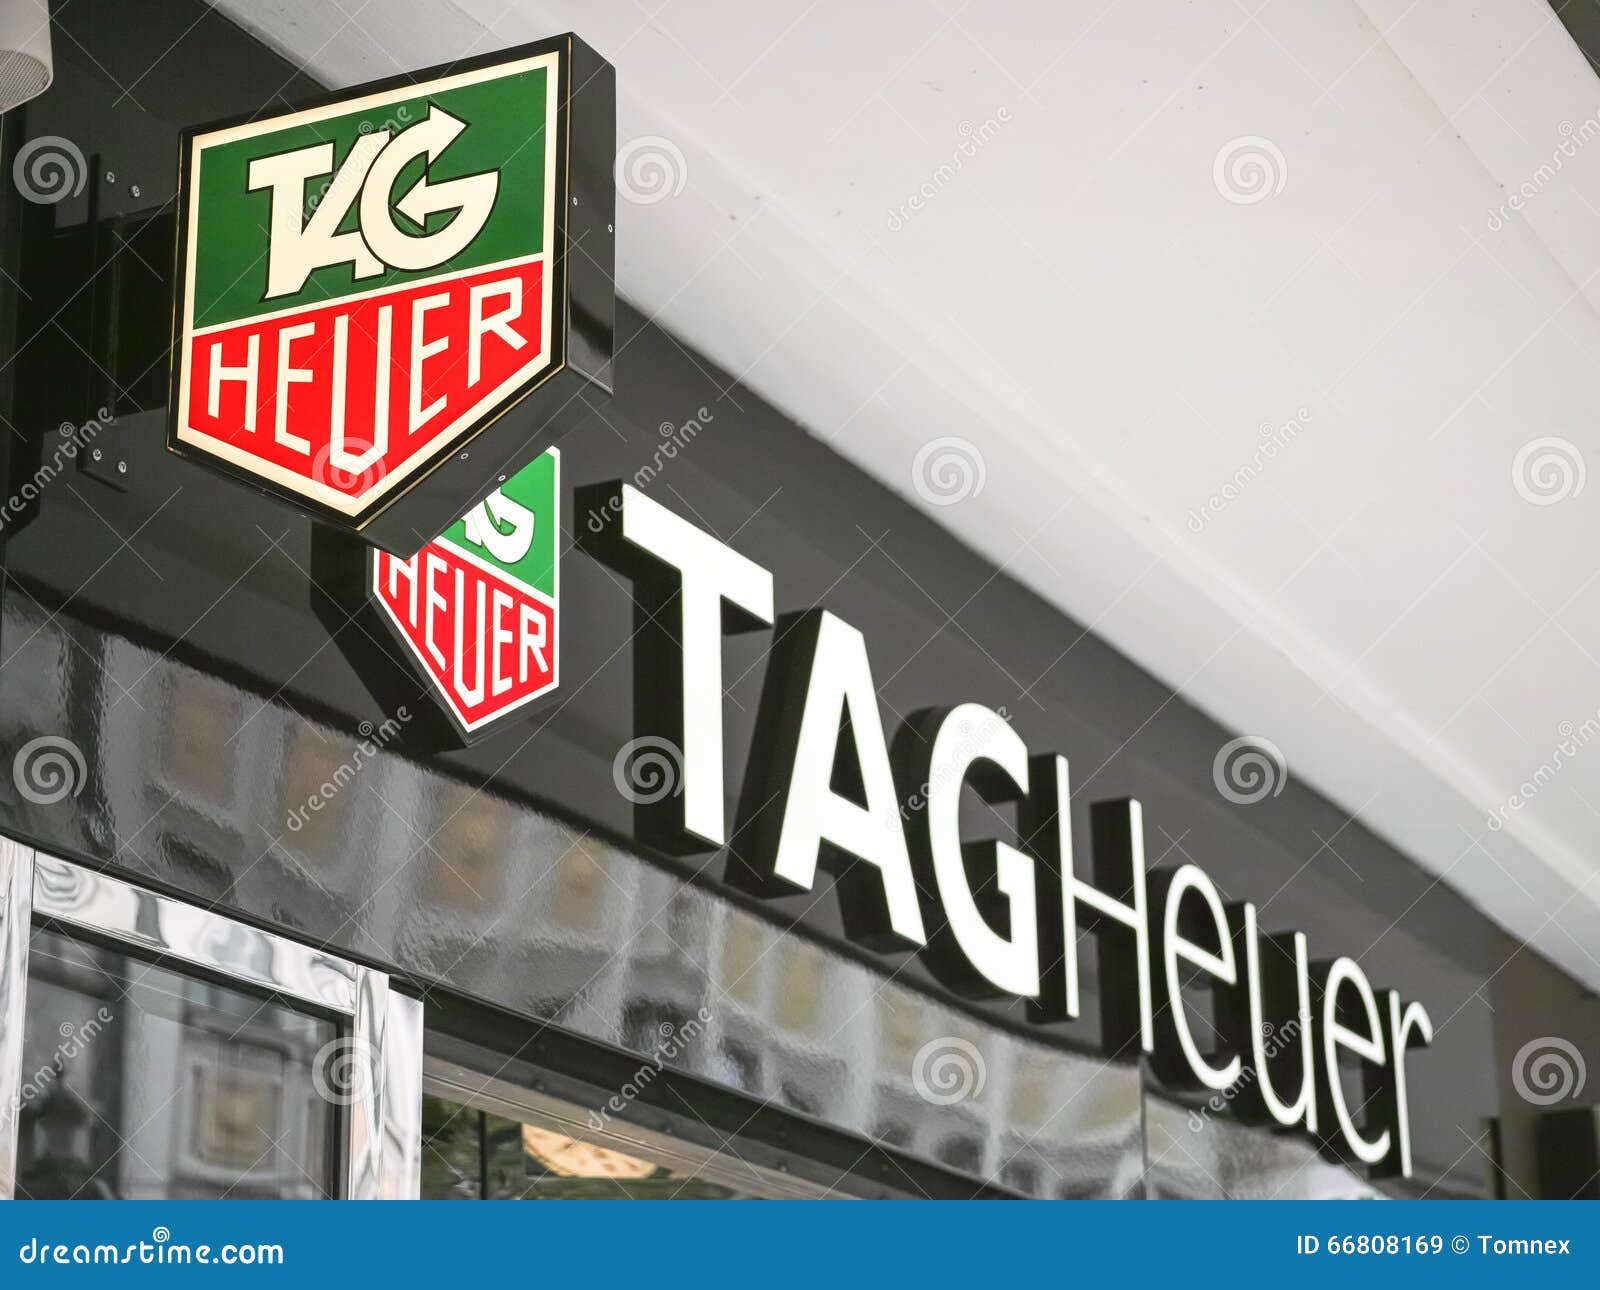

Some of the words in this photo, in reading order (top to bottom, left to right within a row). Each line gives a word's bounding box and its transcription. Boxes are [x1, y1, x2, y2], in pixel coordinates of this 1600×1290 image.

[245, 101, 500, 302] TAG
[207, 276, 529, 476] HEUER
[389, 551, 549, 708] HEUER
